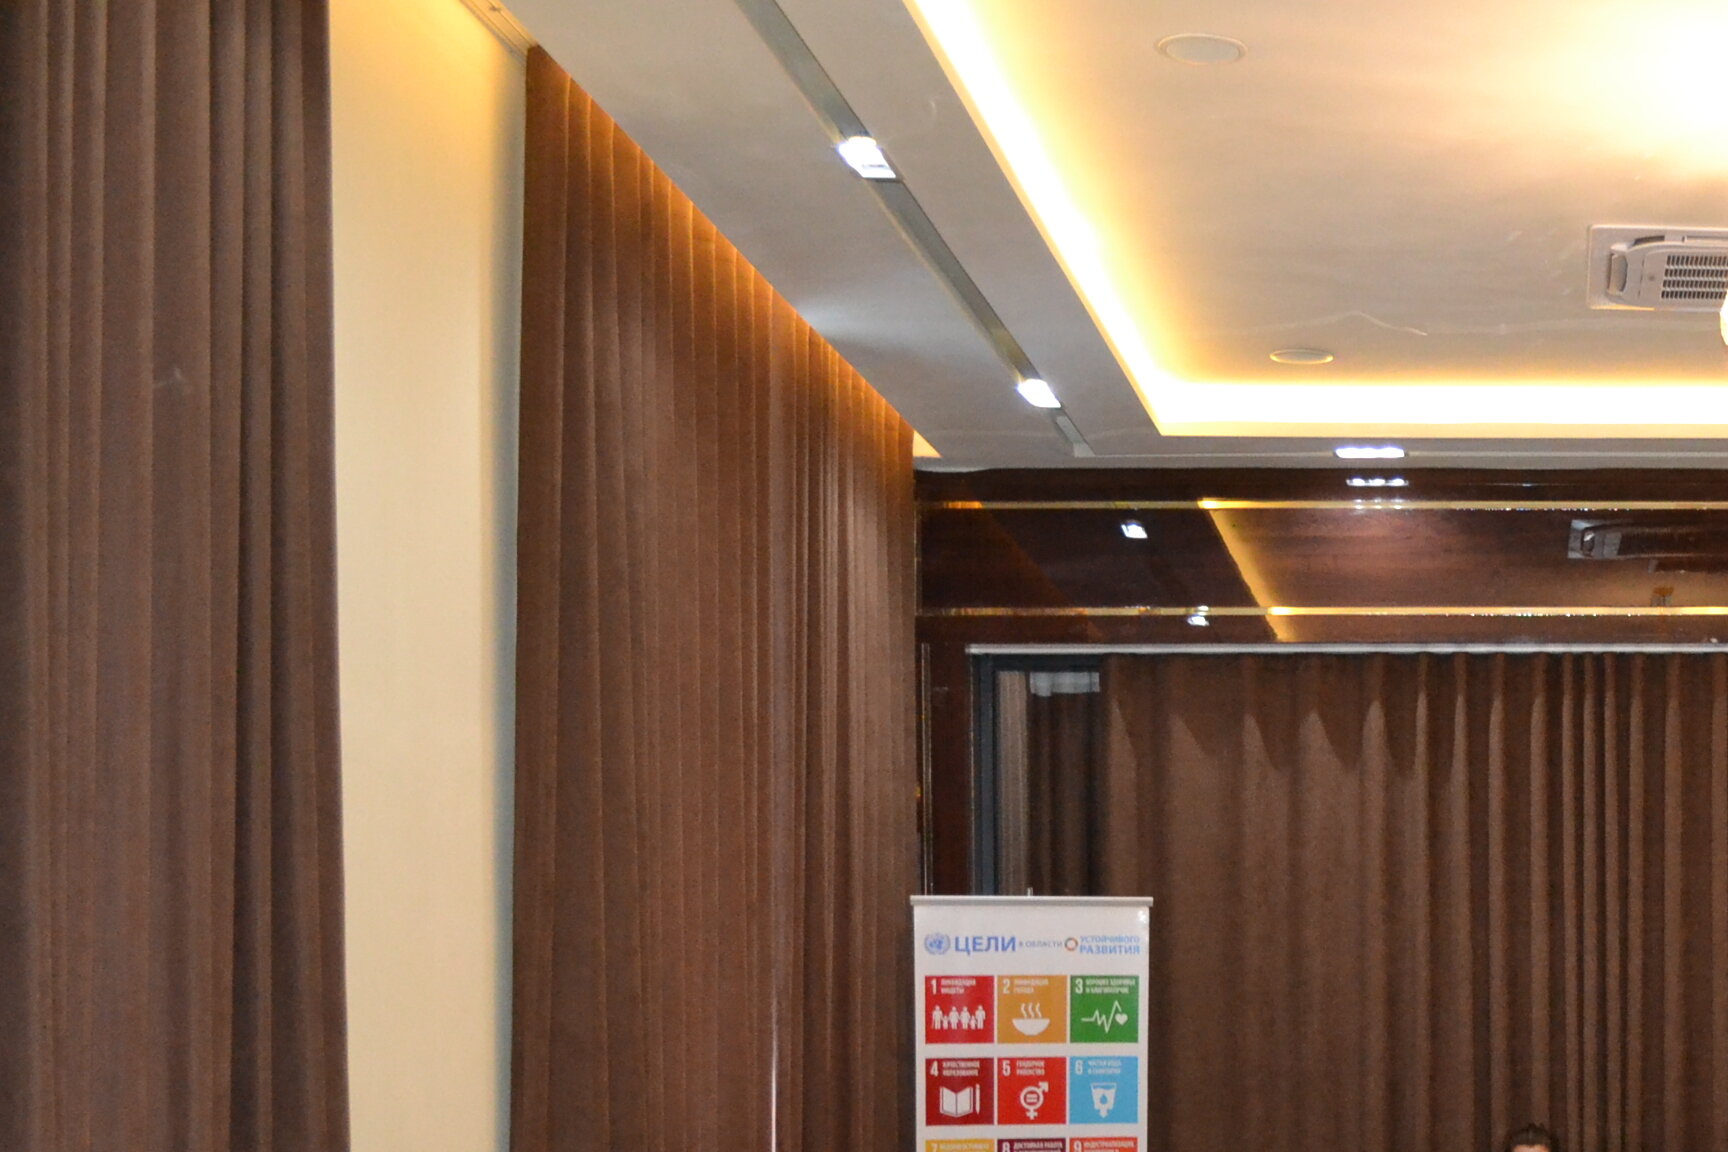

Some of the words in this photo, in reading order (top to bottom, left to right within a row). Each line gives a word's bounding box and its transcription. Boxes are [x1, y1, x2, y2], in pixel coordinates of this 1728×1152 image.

[954, 936, 1016, 955] ЦЕЛИ
[1079, 945, 1140, 954] РАЗВИТИЯ
[931, 978, 937, 995] 1
[1003, 979, 1010, 994] 2
[1075, 978, 1083, 994] 3
[930, 1060, 938, 1077] 4
[1002, 1060, 1010, 1076] 5
